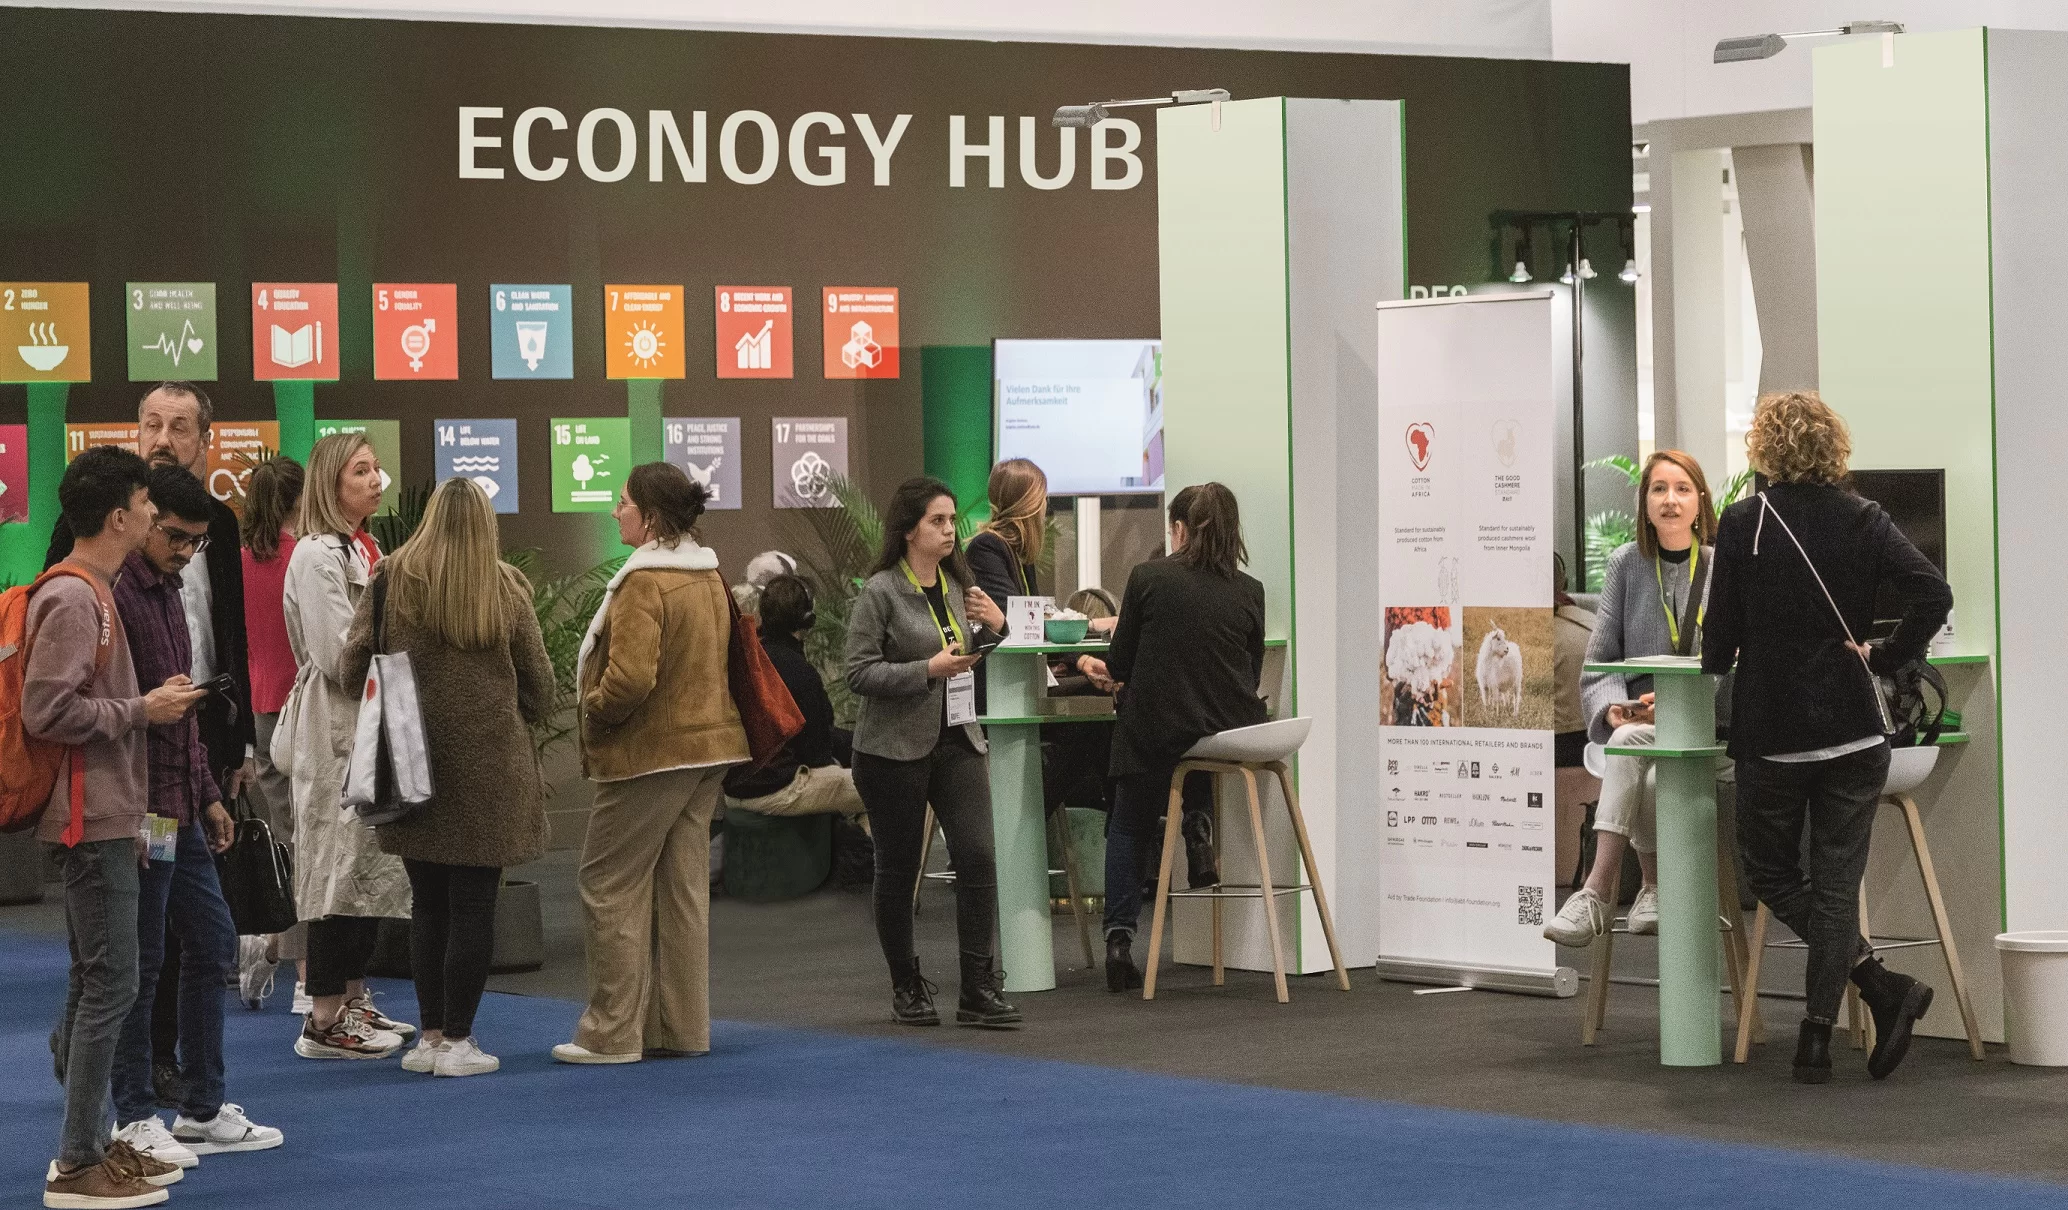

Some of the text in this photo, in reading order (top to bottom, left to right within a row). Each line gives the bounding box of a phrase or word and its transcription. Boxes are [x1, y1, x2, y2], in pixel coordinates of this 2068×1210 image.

[458, 106, 1143, 190] ECONOGY HUB
[4, 289, 14, 310] 2
[132, 290, 144, 310] 3
[258, 289, 268, 310] 4
[378, 290, 388, 310] 5
[496, 290, 506, 312] 6
[610, 292, 619, 312] 7
[720, 292, 730, 312] 8
[828, 294, 838, 313] 9
[1006, 384, 1081, 394] Vielen Dank für Ihre
[1006, 396, 1068, 405] Aufmerksamkeit
[69, 430, 84, 452] 11
[438, 426, 455, 446] 14
[554, 424, 571, 445] 15
[666, 424, 683, 444] 16
[775, 424, 790, 444] 17
[1422, 816, 1437, 825] OTTO
